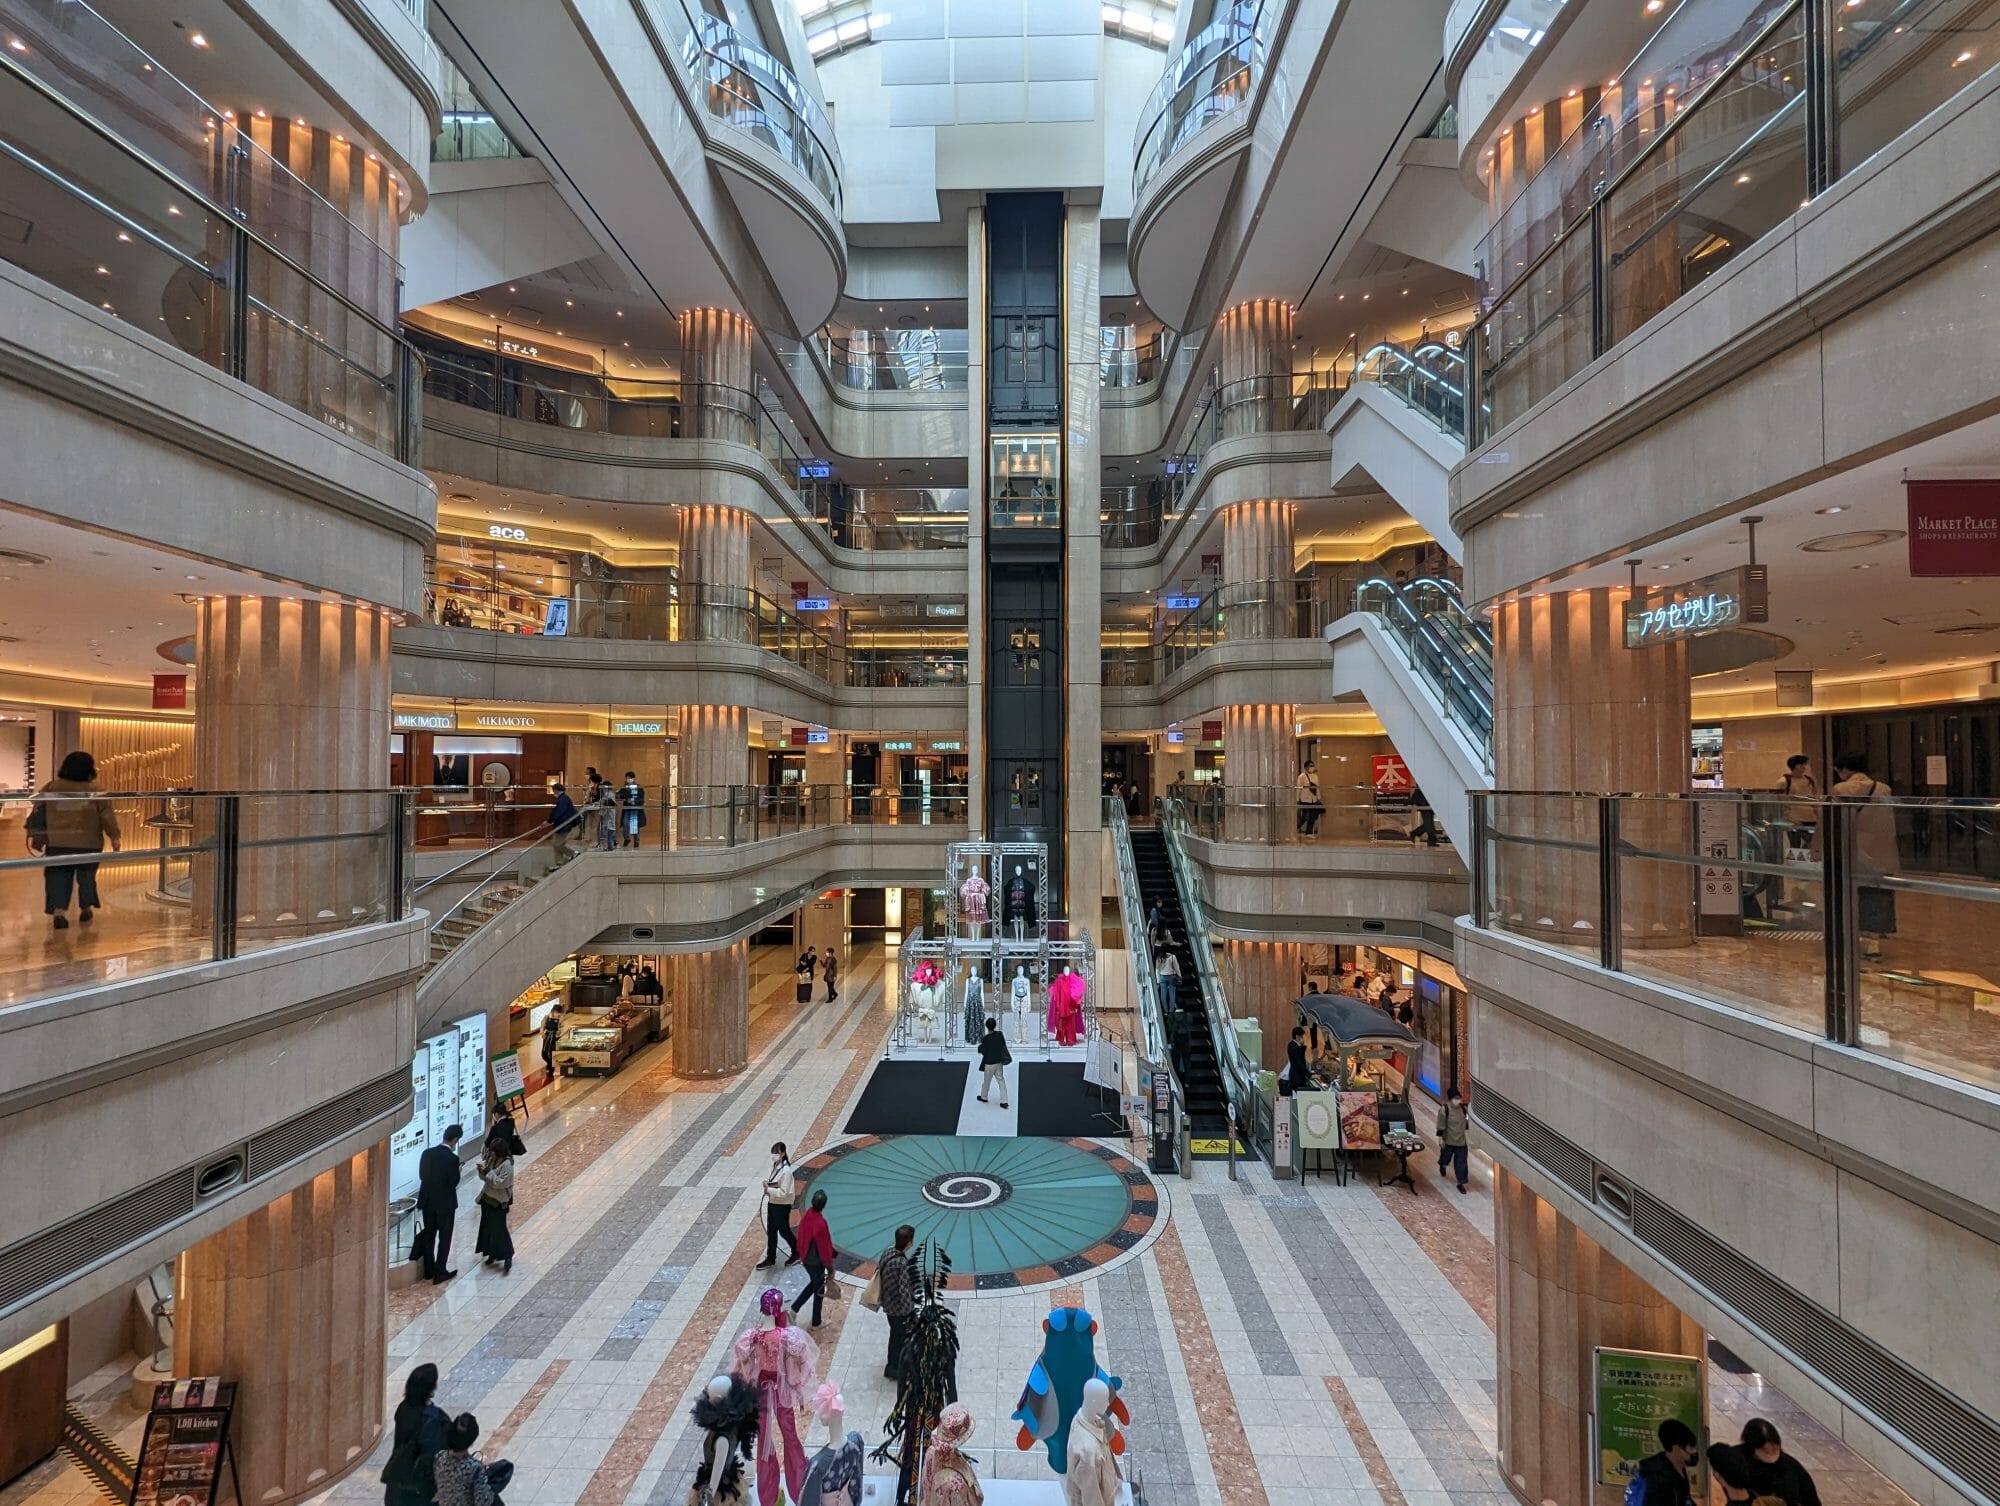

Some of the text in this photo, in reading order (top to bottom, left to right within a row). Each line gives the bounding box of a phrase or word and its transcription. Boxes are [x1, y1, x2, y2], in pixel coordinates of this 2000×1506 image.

[1918, 516, 1998, 530] MARKET PLACE
[489, 525, 529, 541] ace.
[1919, 532, 1941, 540] SHOPS
[1948, 532, 1997, 540] RESTAURANTS
[935, 606, 957, 616] Royal
[1640, 593, 1733, 636] アクセサリー
[398, 714, 450, 729] MIKIMOTO
[476, 716, 535, 727] MIKIMOTO
[1376, 758, 1407, 790] 本
[193, 1417, 218, 1428] kitchen
